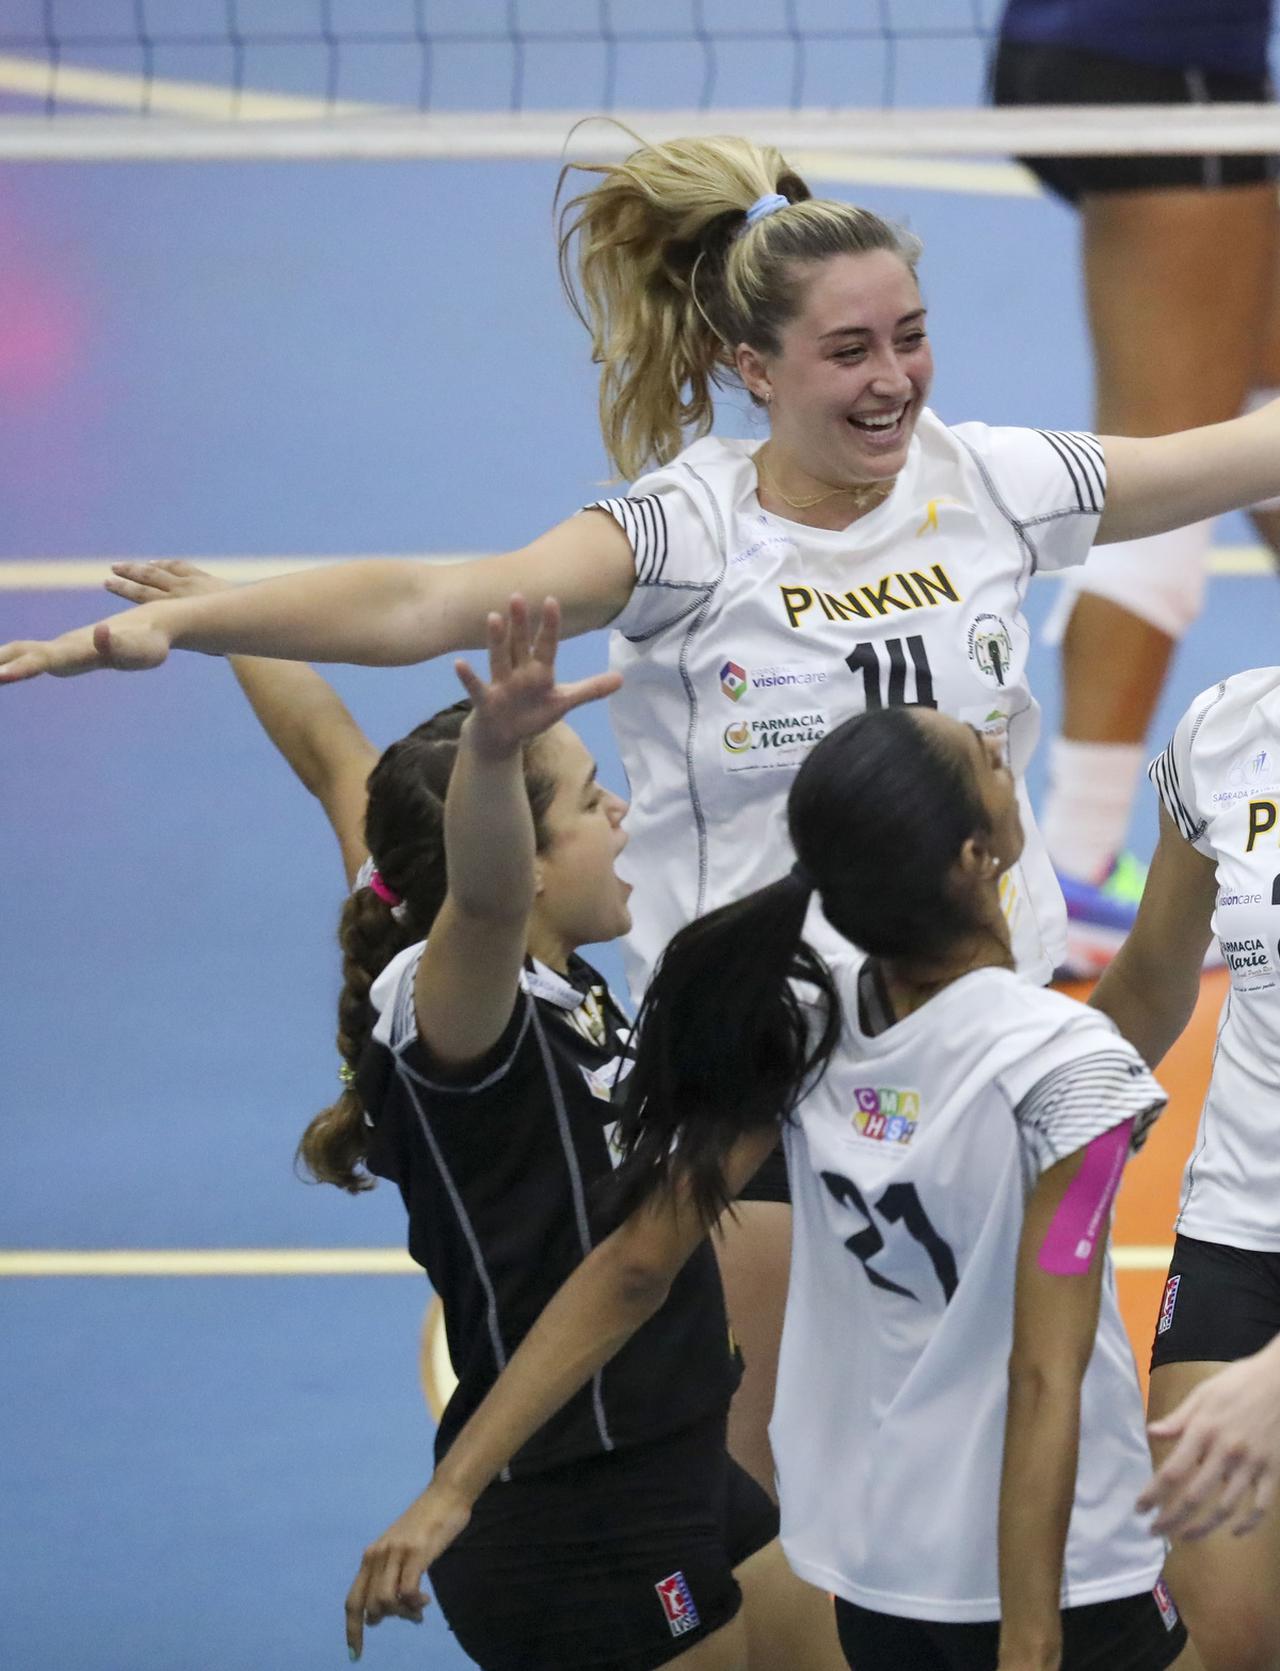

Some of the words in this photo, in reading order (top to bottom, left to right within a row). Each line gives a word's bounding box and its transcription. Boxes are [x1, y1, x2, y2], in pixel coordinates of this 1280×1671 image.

[779, 564, 961, 628] PINKIN
[751, 672, 826, 688] visioncare
[844, 635, 939, 711] 14
[752, 714, 825, 732] FARMACIA
[751, 728, 825, 750] Marie
[857, 1089, 920, 1120] CMA
[819, 1170, 960, 1306] 21
